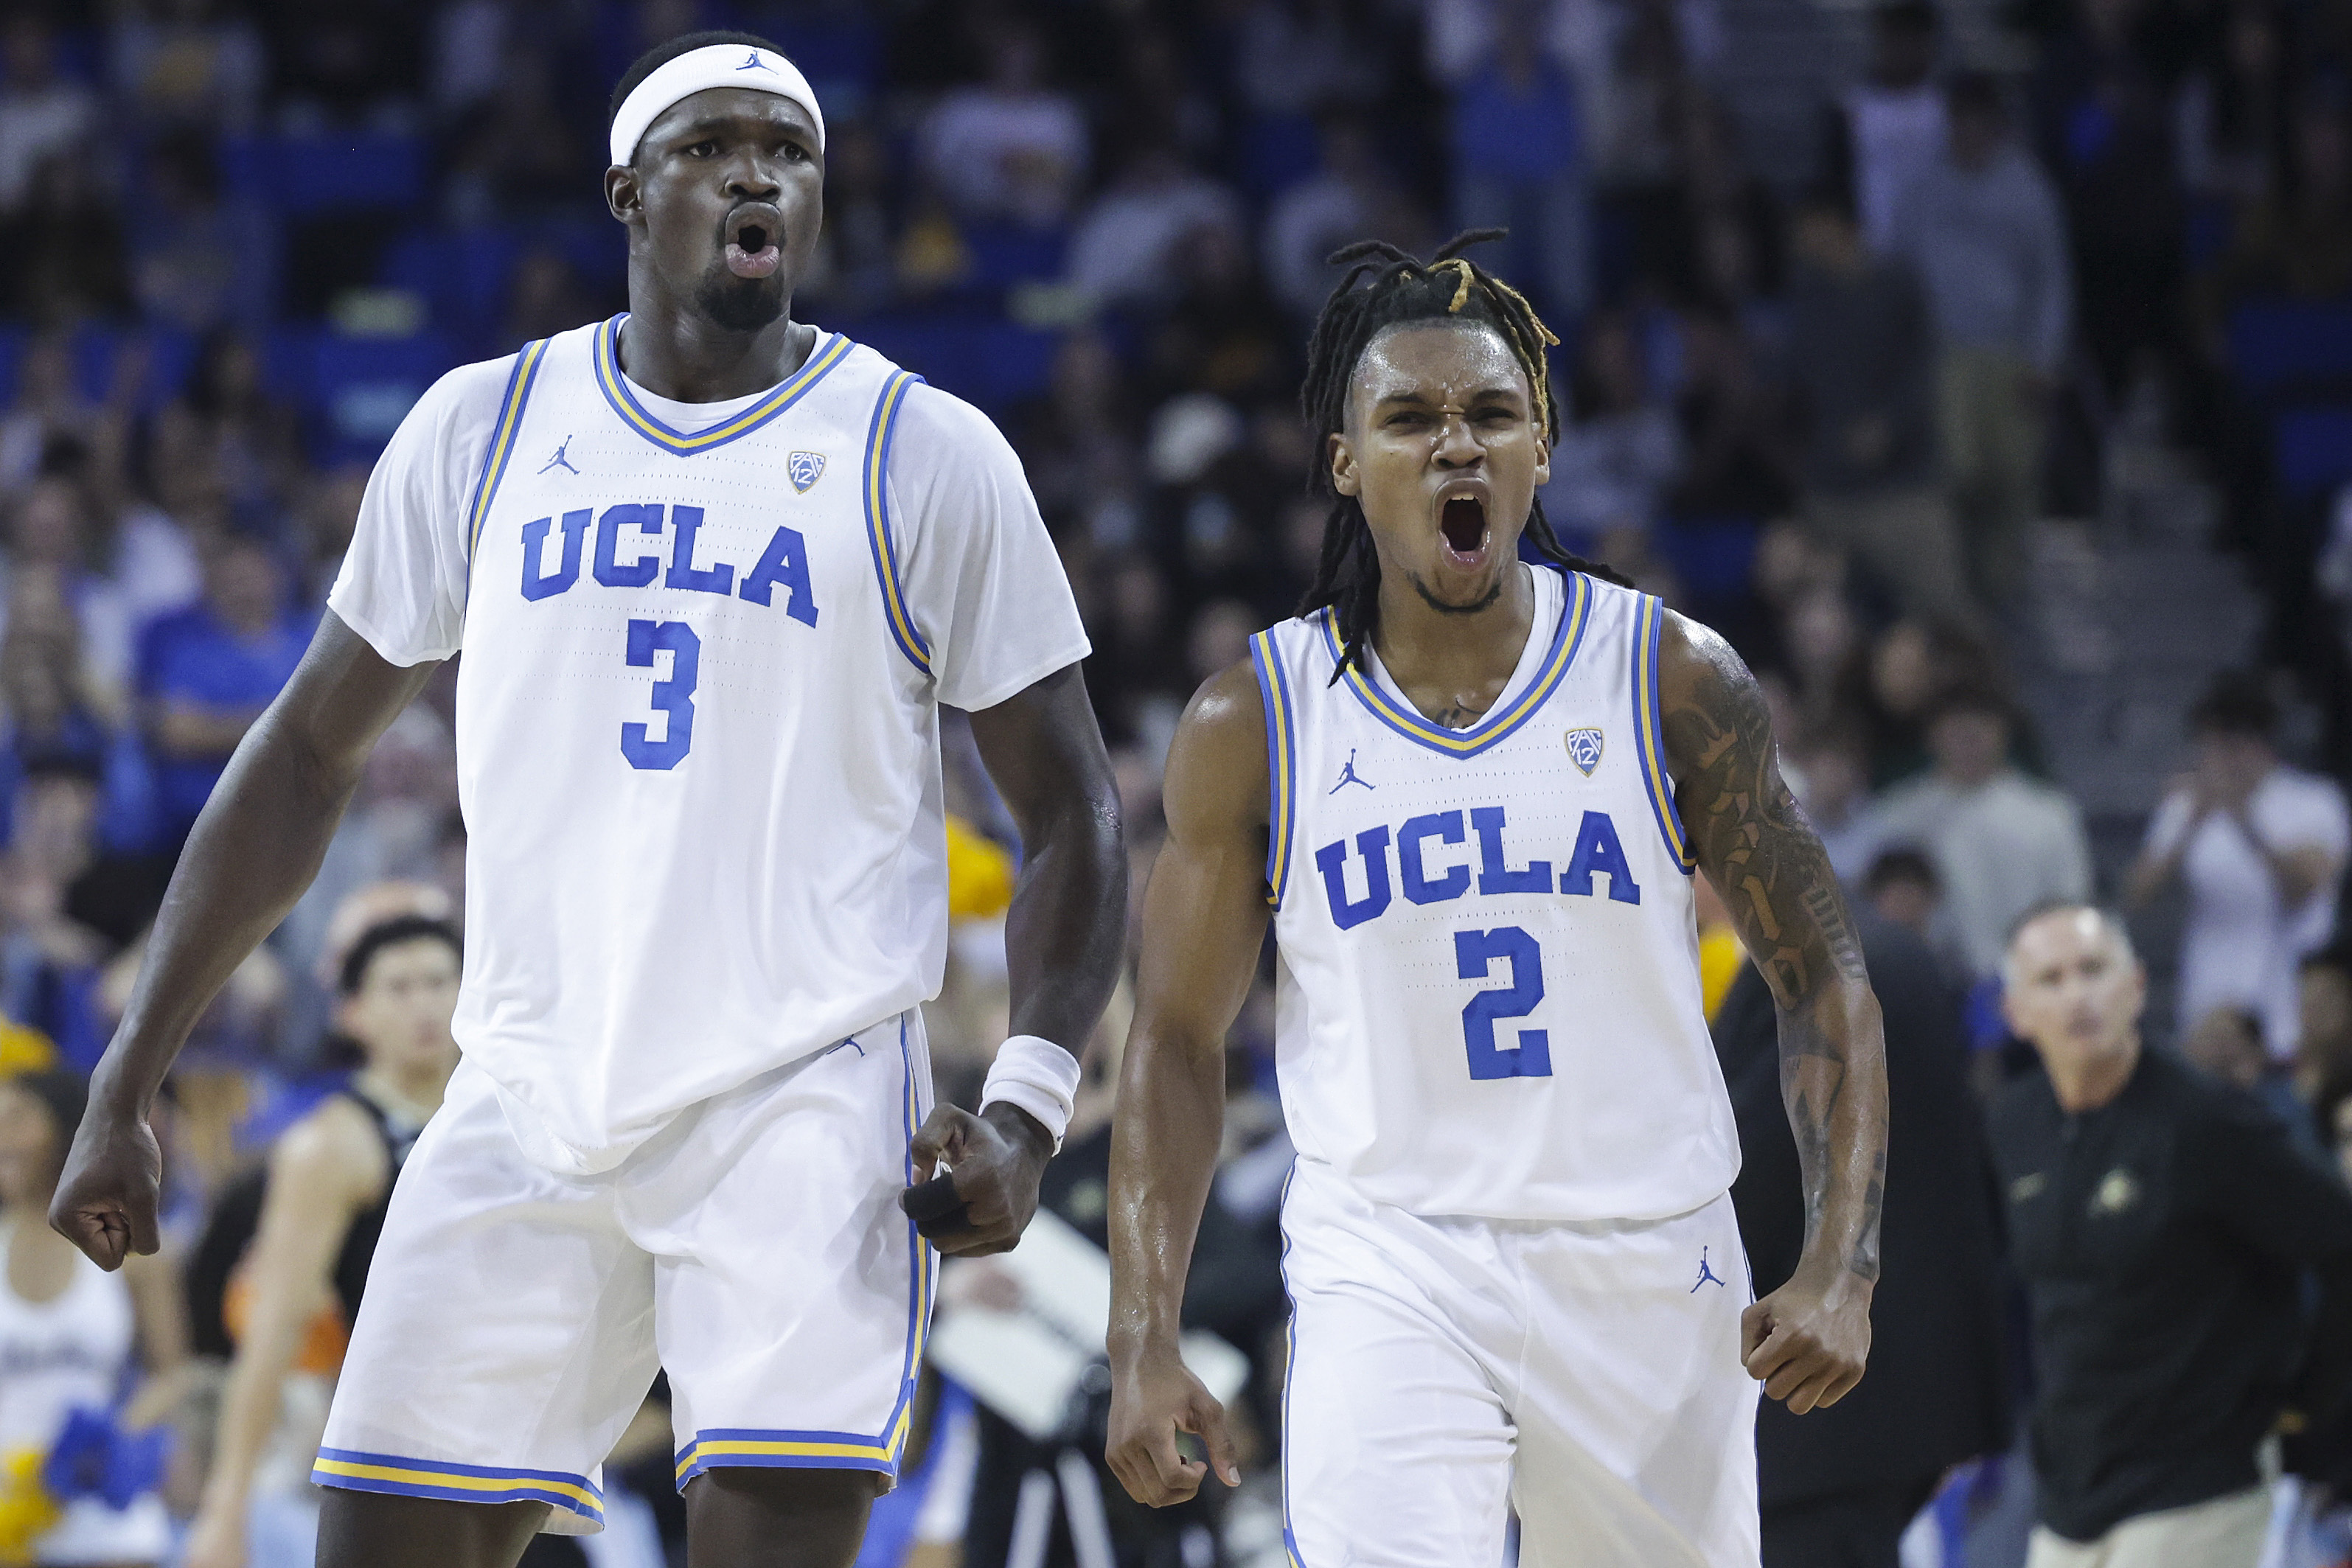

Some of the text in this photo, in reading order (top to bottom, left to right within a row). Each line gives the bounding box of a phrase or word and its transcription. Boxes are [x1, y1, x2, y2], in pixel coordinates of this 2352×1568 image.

[789, 452, 825, 478] PAC
[793, 468, 813, 484] 12
[521, 503, 819, 629] UCLA
[621, 619, 701, 770] 3
[1567, 729, 1602, 757] PAC
[1576, 747, 1596, 765] 12
[1315, 806, 1641, 931] UCLA
[1454, 926, 1553, 1081] 2
